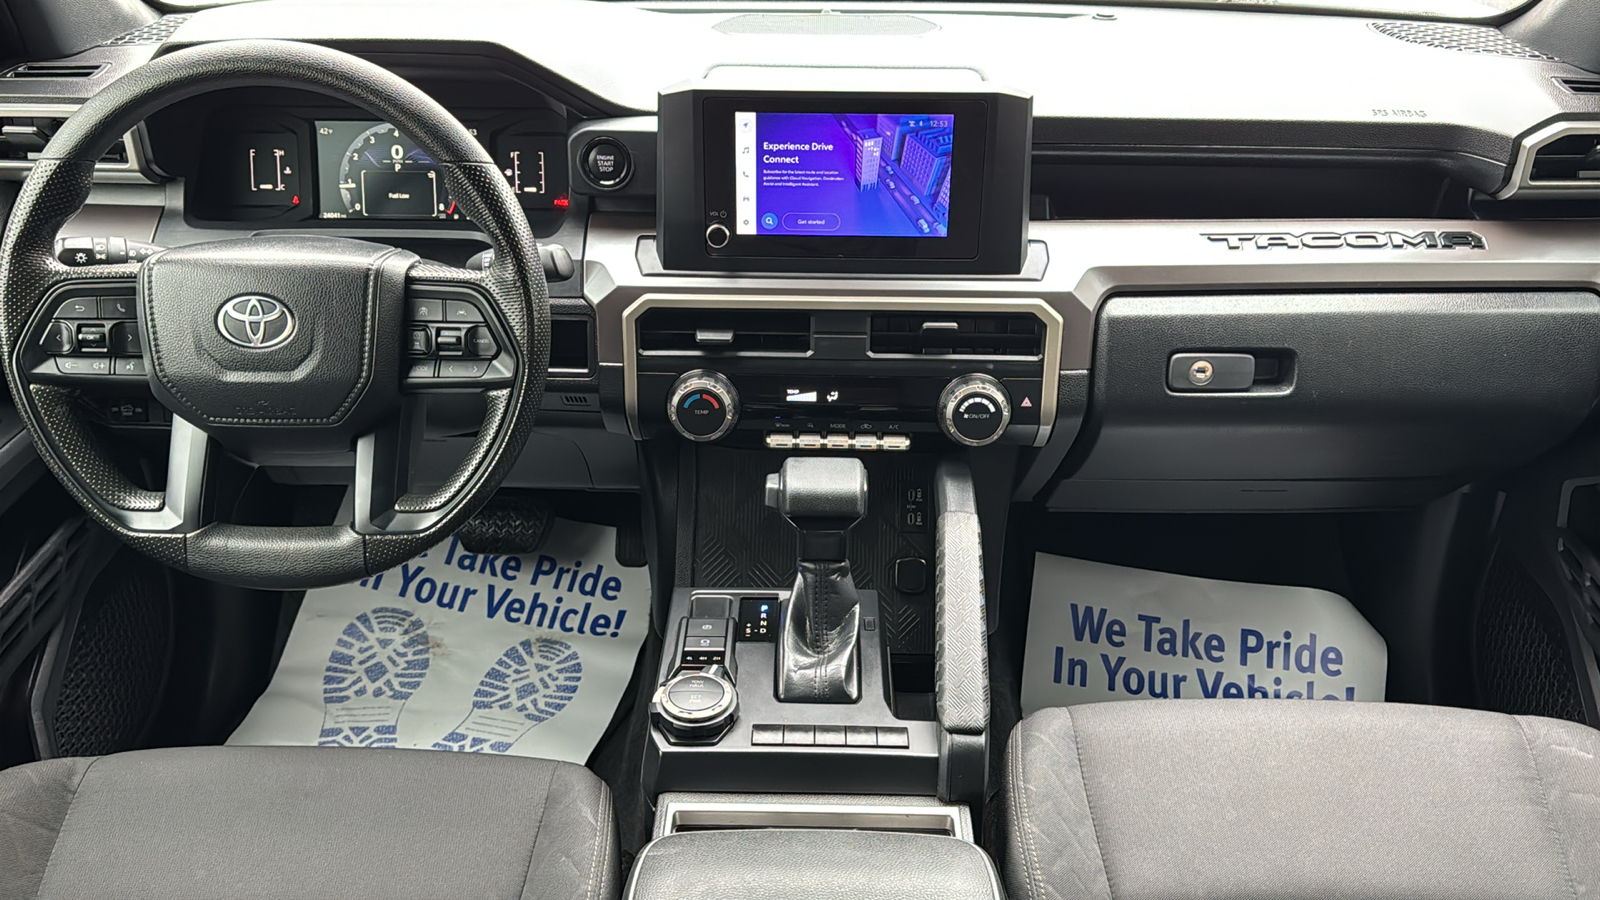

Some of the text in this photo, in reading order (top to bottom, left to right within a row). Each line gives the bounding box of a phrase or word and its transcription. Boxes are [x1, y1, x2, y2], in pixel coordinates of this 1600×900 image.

[1371, 109, 1428, 118] SRS AIRBAG
[391, 144, 404, 160] 0
[763, 141, 834, 152] Experience Drive
[763, 154, 799, 164] Connect
[1199, 230, 1488, 250] TACOMA
[529, 554, 622, 601] Pride
[398, 563, 627, 638] Your Vehicle!
[760, 604, 769, 612] P
[1069, 602, 1344, 677] We Take Pride
[1053, 646, 1355, 702] In Your Vehi
